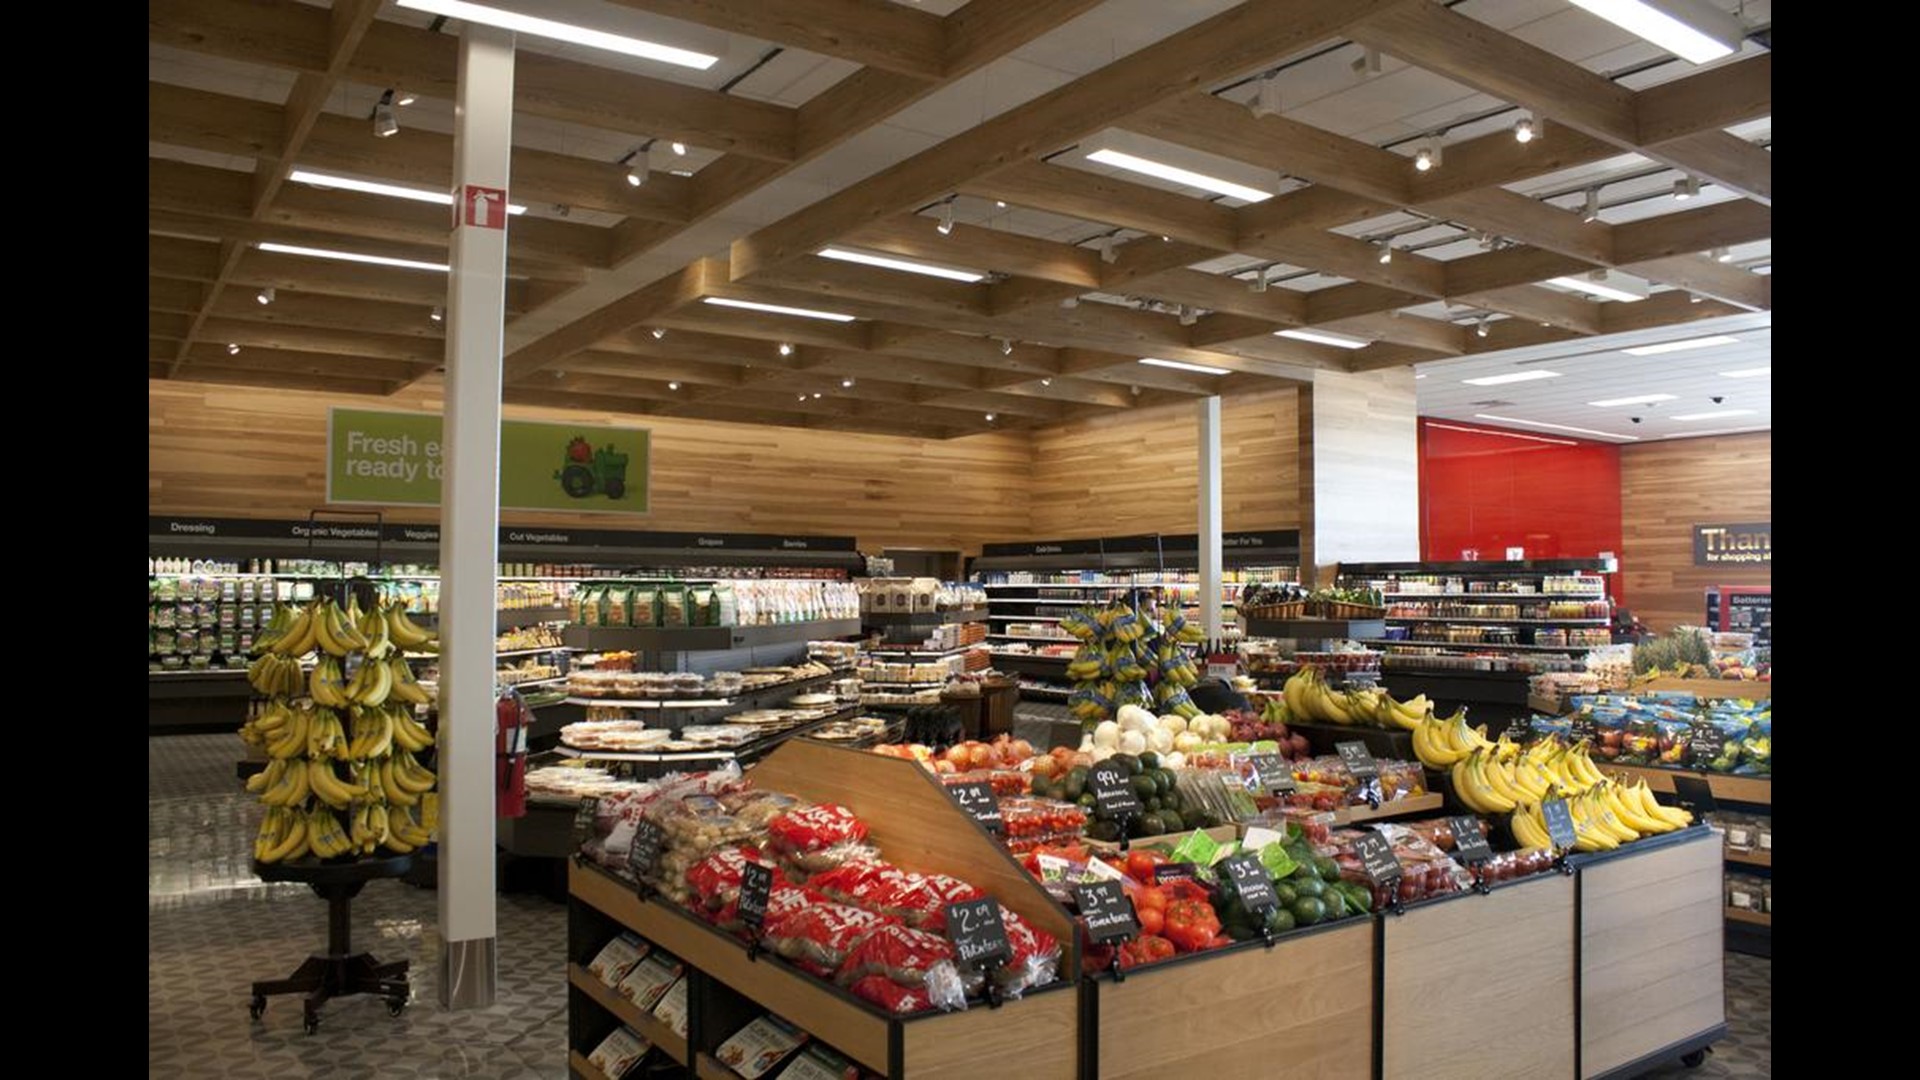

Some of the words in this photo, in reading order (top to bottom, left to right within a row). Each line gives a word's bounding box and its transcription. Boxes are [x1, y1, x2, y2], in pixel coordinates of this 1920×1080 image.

[347, 431, 418, 456] Fresh
[345, 457, 419, 482] ready
[170, 522, 216, 534] Dressing
[330, 528, 379, 538] Vegetables
[404, 529, 439, 539] Veggies
[509, 532, 524, 541] Cut
[1701, 528, 1771, 551] Than
[1720, 552, 1761, 563] shopping
